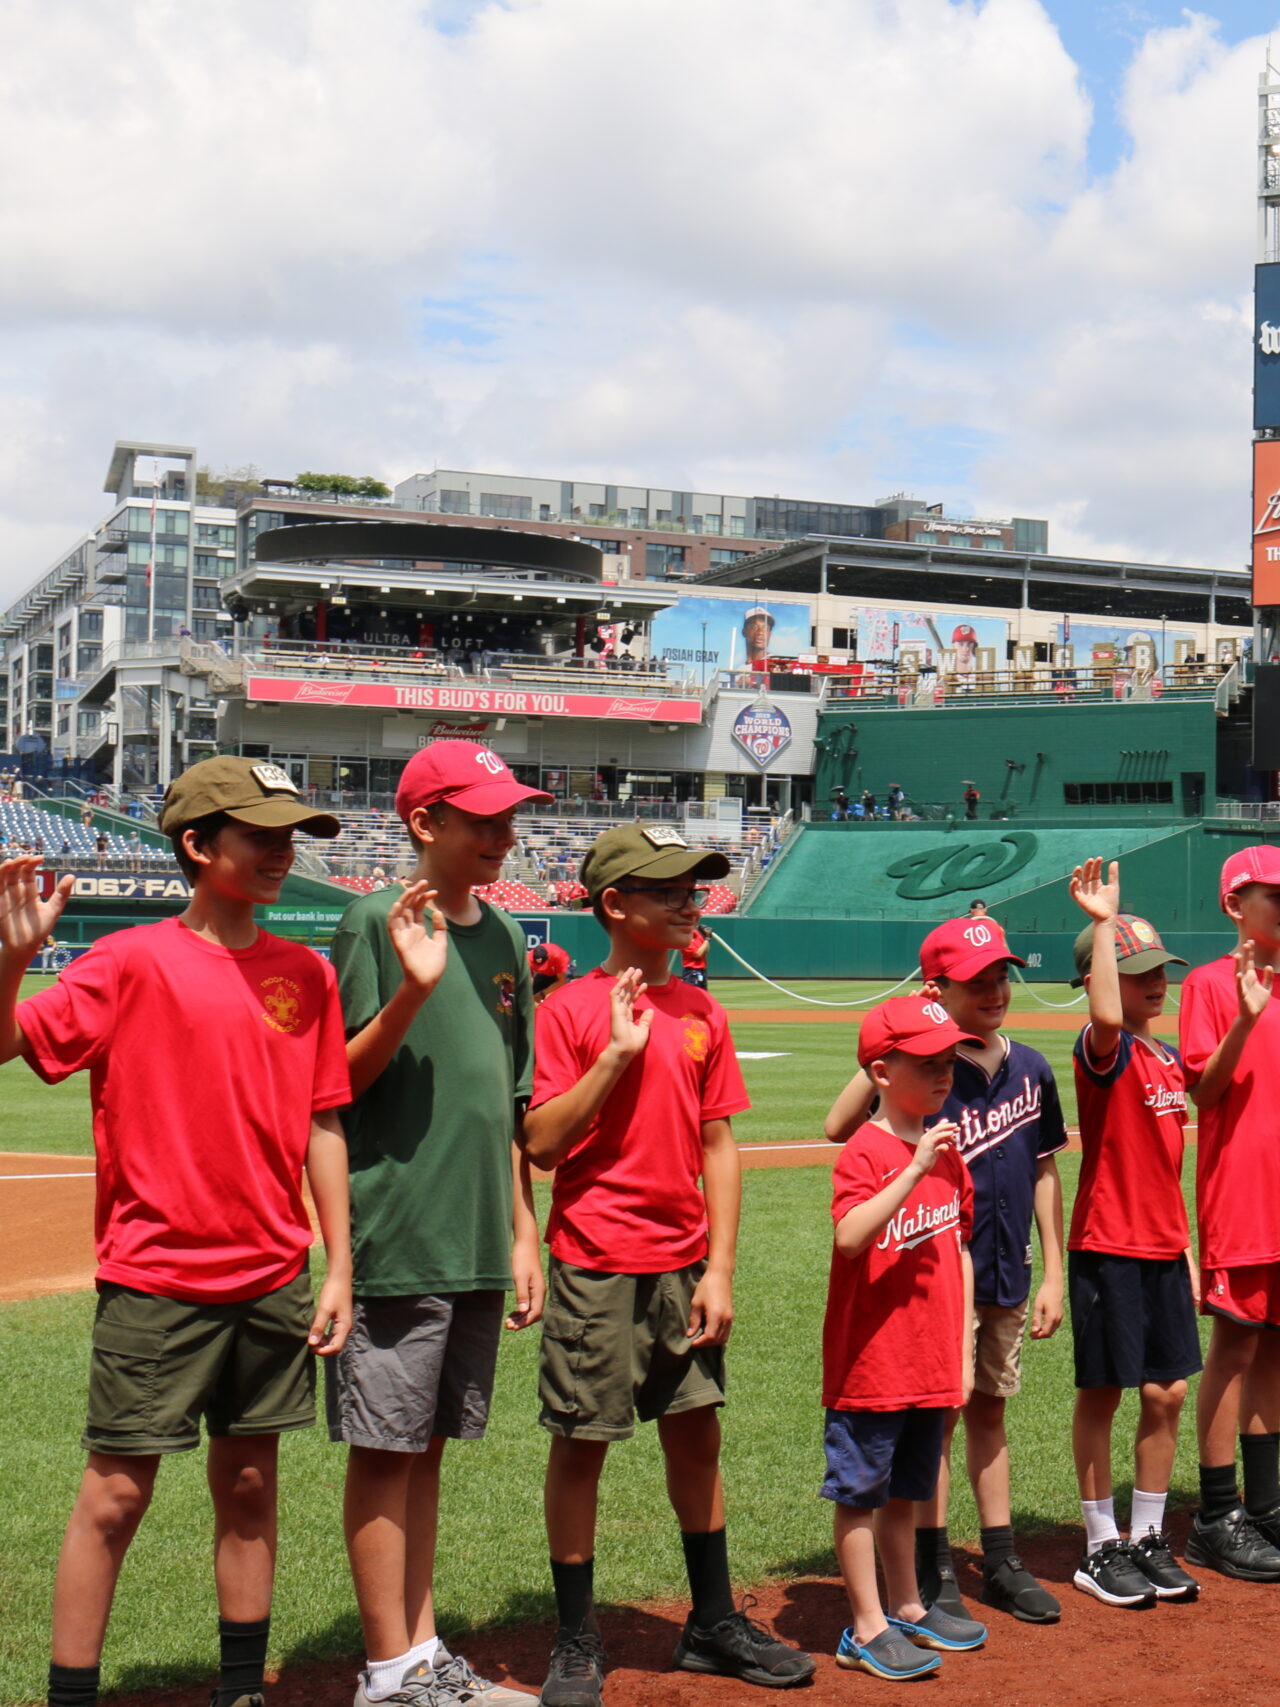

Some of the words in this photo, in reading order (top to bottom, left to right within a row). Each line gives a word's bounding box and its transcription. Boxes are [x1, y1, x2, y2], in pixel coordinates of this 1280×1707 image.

[363, 632, 411, 645] ULTRA
[441, 636, 484, 649] LOFT
[695, 650, 719, 663] GRAY
[301, 686, 349, 698] Budweiser
[395, 687, 434, 705] THIS
[438, 689, 490, 708] BUD'S
[494, 693, 527, 711] FOR
[531, 695, 570, 713] YOU.
[613, 702, 656, 714] Budweiser
[744, 716, 782, 726] WORLD
[432, 725, 483, 736] Budweiser
[735, 724, 790, 737] CHAMPIONS
[887, 831, 1039, 900] W
[144, 879, 195, 897] FA
[269, 912, 282, 920] Put
[296, 912, 315, 920] bank
[316, 912, 325, 920] in
[964, 924, 992, 946] W
[1027, 953, 1042, 967] 402
[922, 1002, 949, 1024] W
